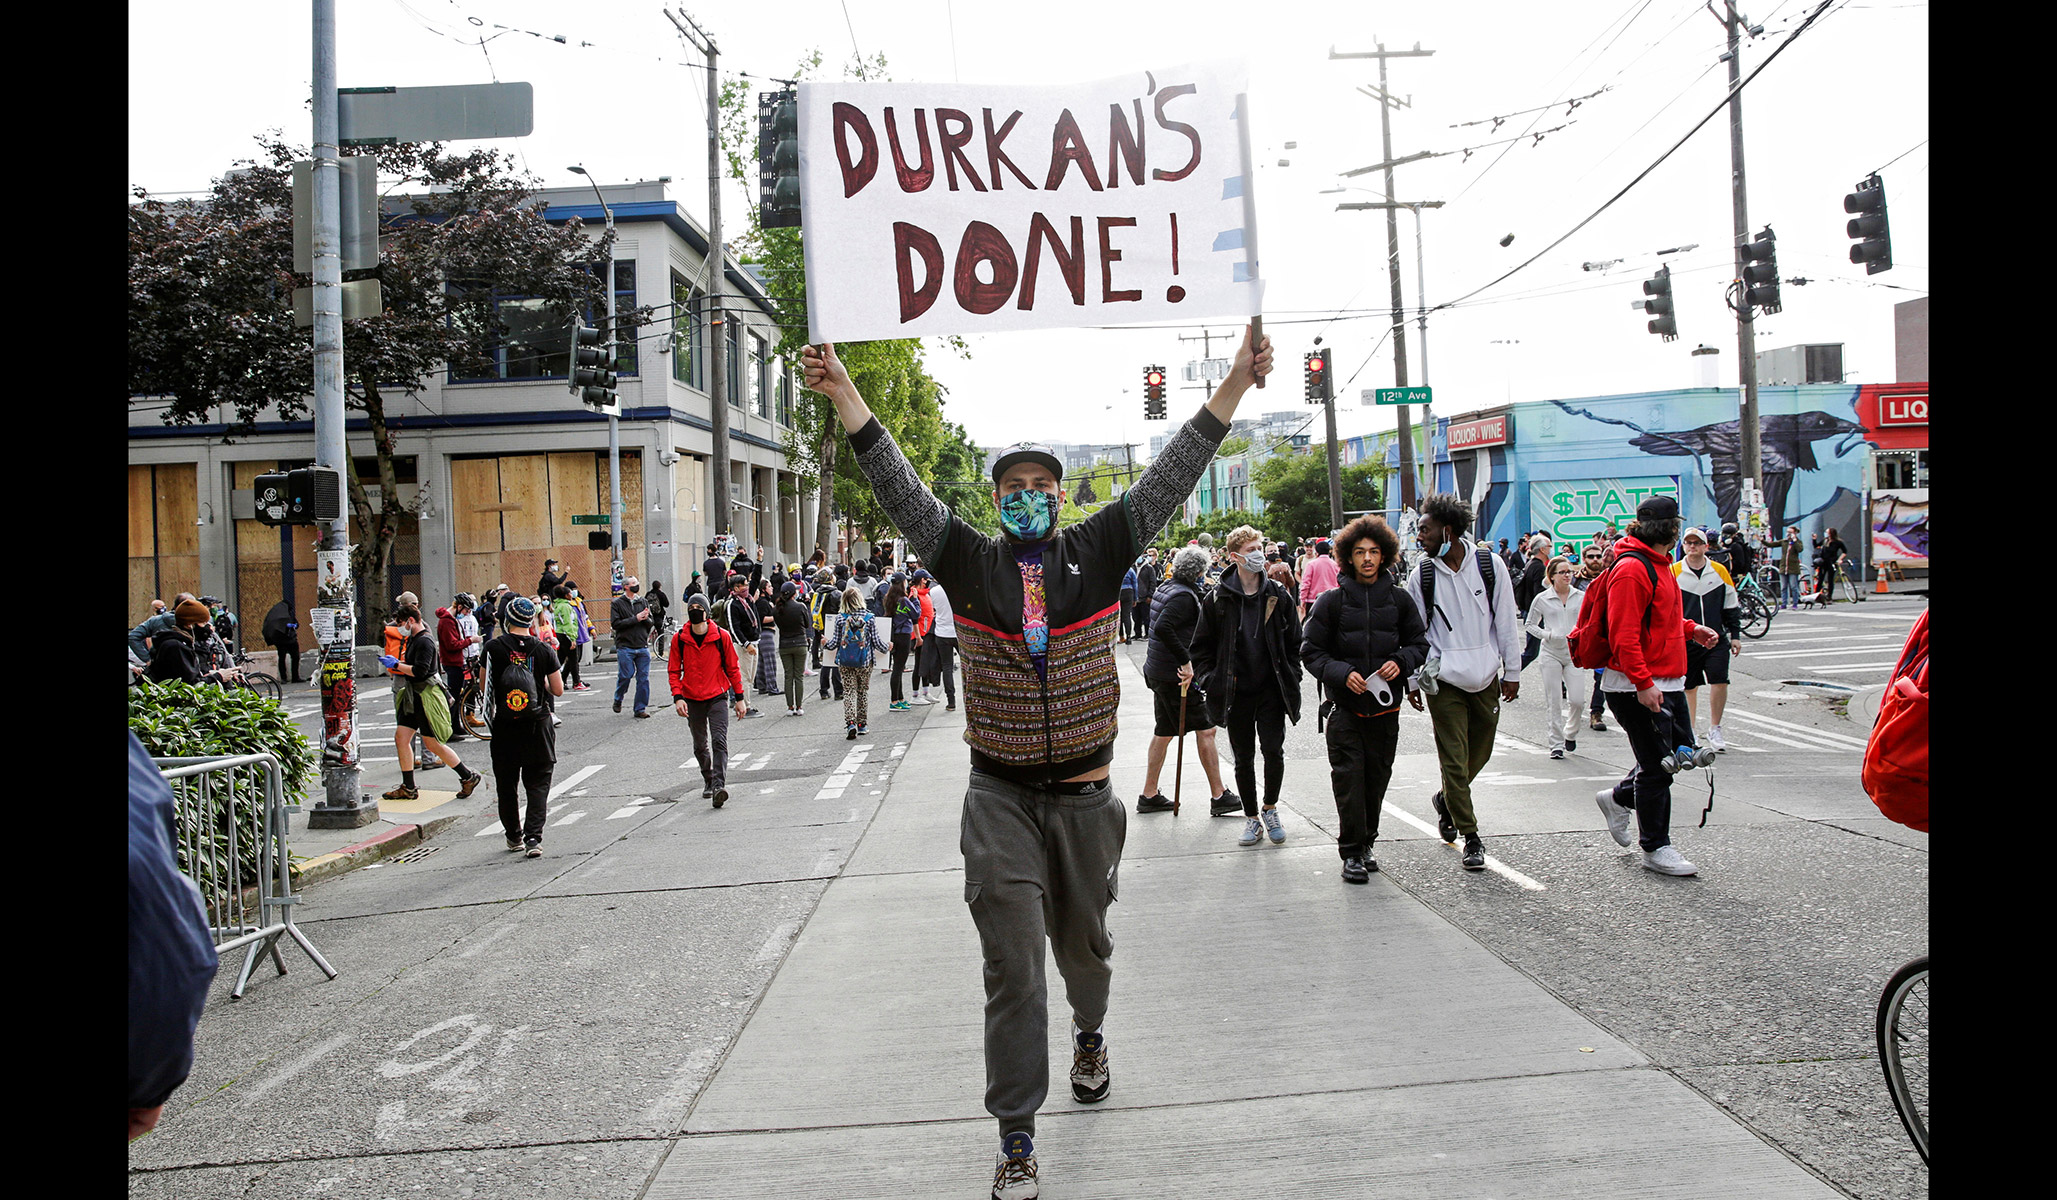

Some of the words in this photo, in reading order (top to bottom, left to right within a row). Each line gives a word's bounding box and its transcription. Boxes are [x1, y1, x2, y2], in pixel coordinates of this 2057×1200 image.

[832, 70, 1202, 199] DURKAN'S
[893, 212, 1186, 324] DONE!
[1382, 391, 1403, 402] 12th
[1408, 391, 1427, 401] Ave
[1889, 400, 1928, 419] LIQ
[1449, 427, 1477, 446] LIQUOR
[1480, 422, 1503, 441] WINE
